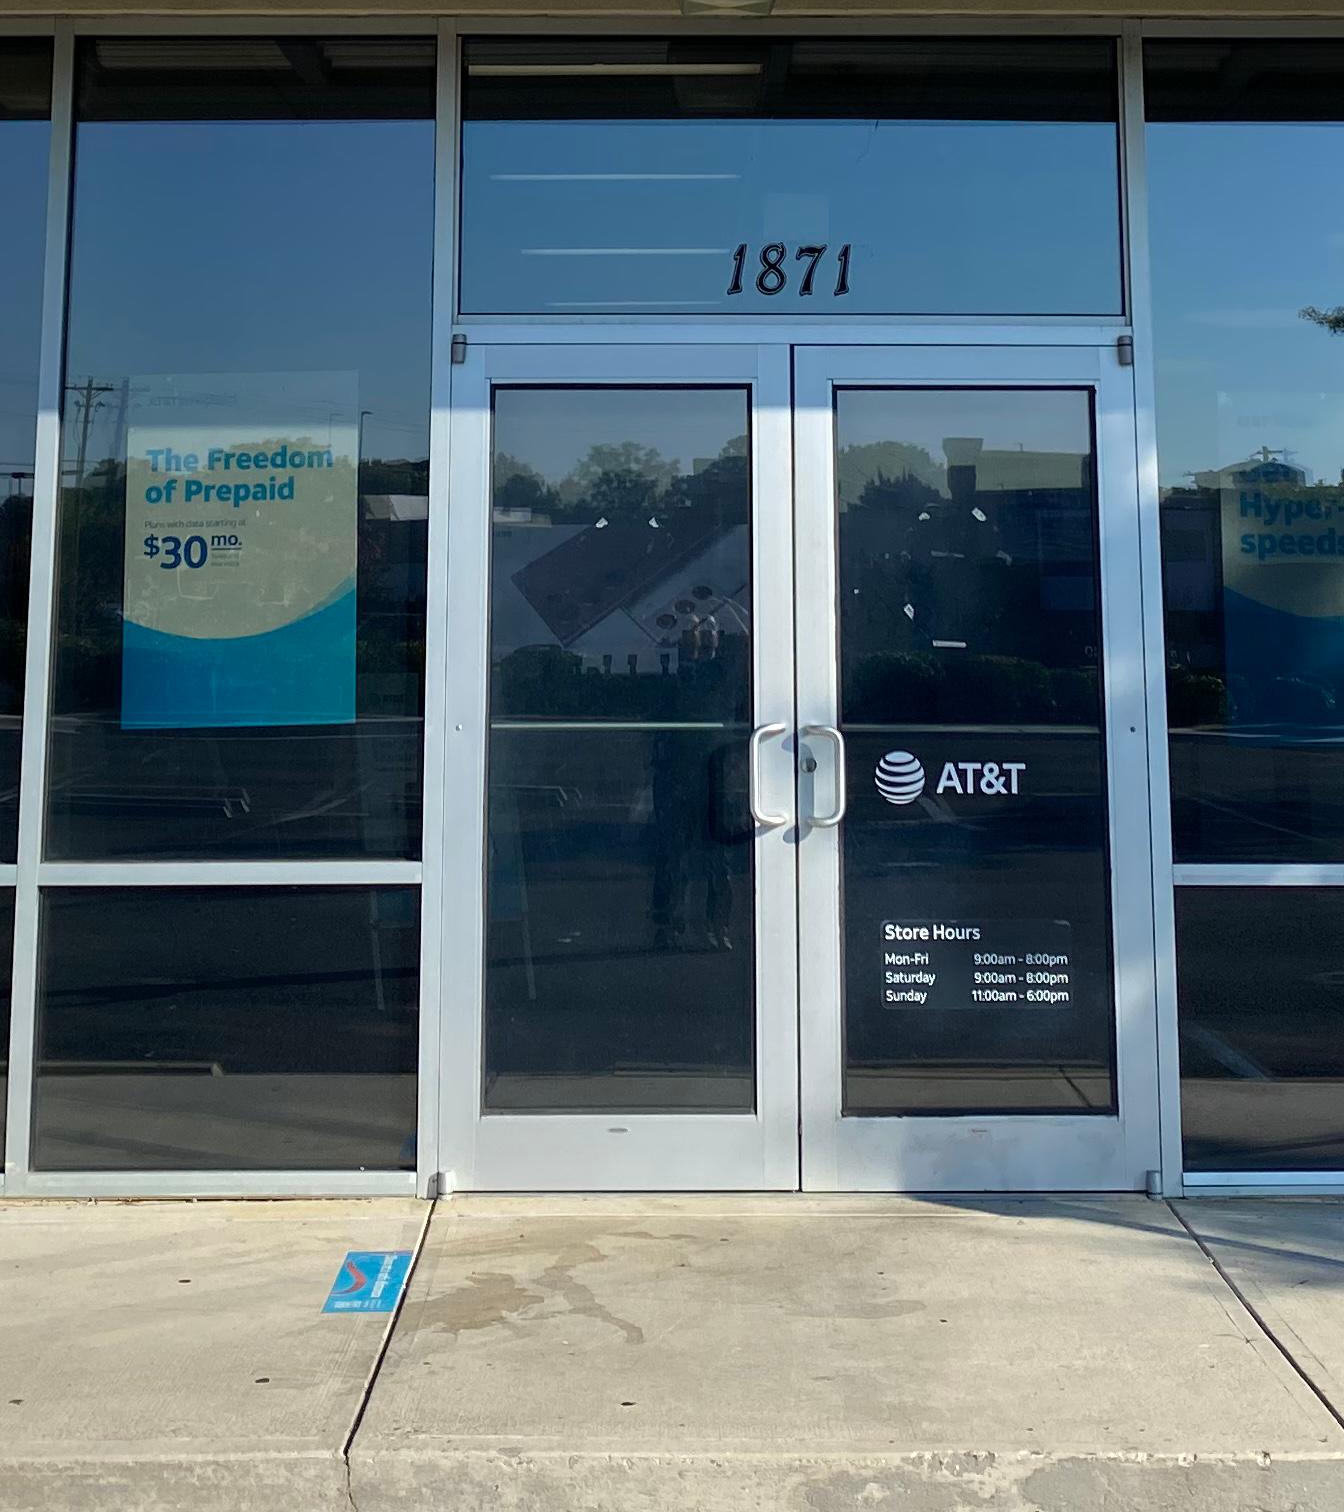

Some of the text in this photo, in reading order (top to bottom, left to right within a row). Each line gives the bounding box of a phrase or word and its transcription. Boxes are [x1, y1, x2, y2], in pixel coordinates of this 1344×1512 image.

[726, 241, 851, 296] 1871
[145, 444, 334, 473] The Freedom
[145, 476, 296, 507] of Prepaid
[166, 520, 185, 528] with
[185, 520, 204, 528] data
[205, 519, 236, 529] starting
[143, 533, 208, 569] $30
[211, 534, 243, 546] mo.
[936, 762, 1026, 795] AT&T
[884, 924, 981, 940] Store Hours
[885, 953, 929, 965] Mon-Fri
[973, 954, 1016, 965] 9:00am
[1025, 954, 1068, 968] 8:00pm
[885, 972, 936, 986] Saturday
[974, 972, 1016, 984] 9:00am
[1026, 972, 1069, 986] 8:00pm
[886, 990, 927, 1004] Sunday
[971, 990, 1017, 1002] 11:00am
[1026, 990, 1069, 1004] 6:00pm
